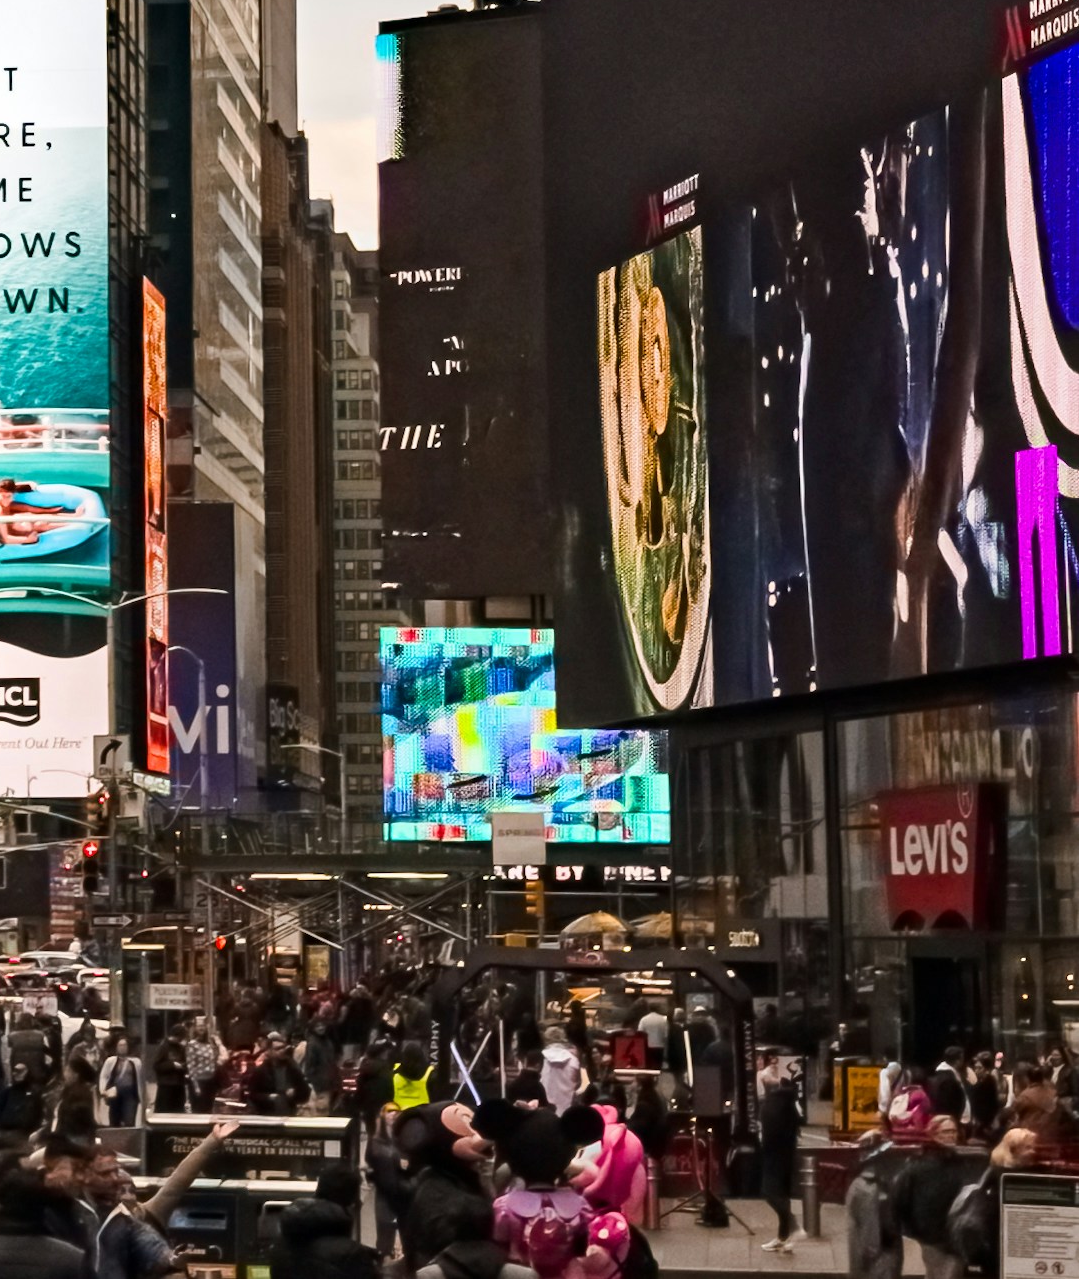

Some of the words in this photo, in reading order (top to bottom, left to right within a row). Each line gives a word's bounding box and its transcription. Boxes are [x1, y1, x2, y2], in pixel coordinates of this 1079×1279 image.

[1030, 7, 1079, 49] MARQUIS
[662, 173, 699, 206] MARRIOTT
[663, 200, 695, 229] MARQUIS
[379, 424, 445, 451] THE
[25, 737, 49, 749] Out
[52, 737, 82, 749] Here
[555, 865, 584, 881] BY
